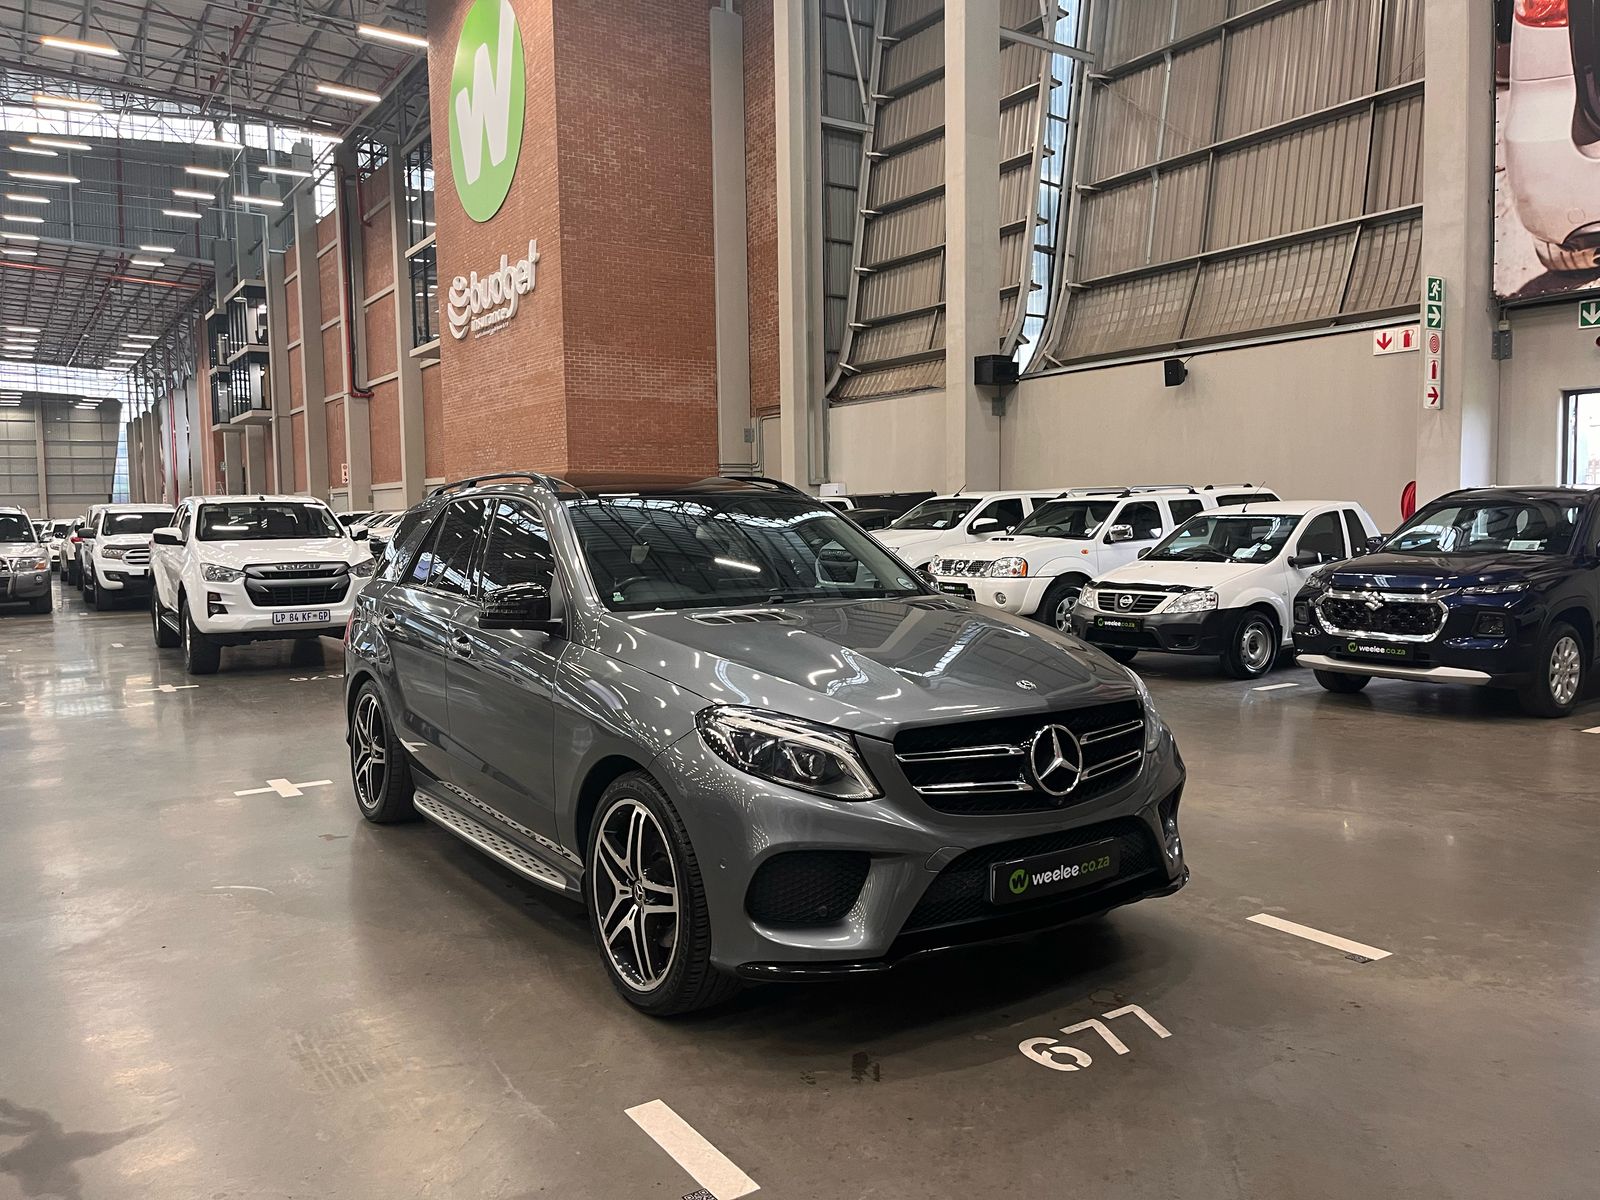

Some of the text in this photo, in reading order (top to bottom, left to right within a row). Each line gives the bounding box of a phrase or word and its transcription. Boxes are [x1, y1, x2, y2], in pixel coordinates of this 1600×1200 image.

[470, 239, 540, 318] budget
[275, 611, 328, 623] LP 84 KF GP
[1358, 645, 1406, 656] weelee.co.za
[1032, 855, 1111, 886] weelee.co.za
[1019, 1003, 1173, 1072] 677
